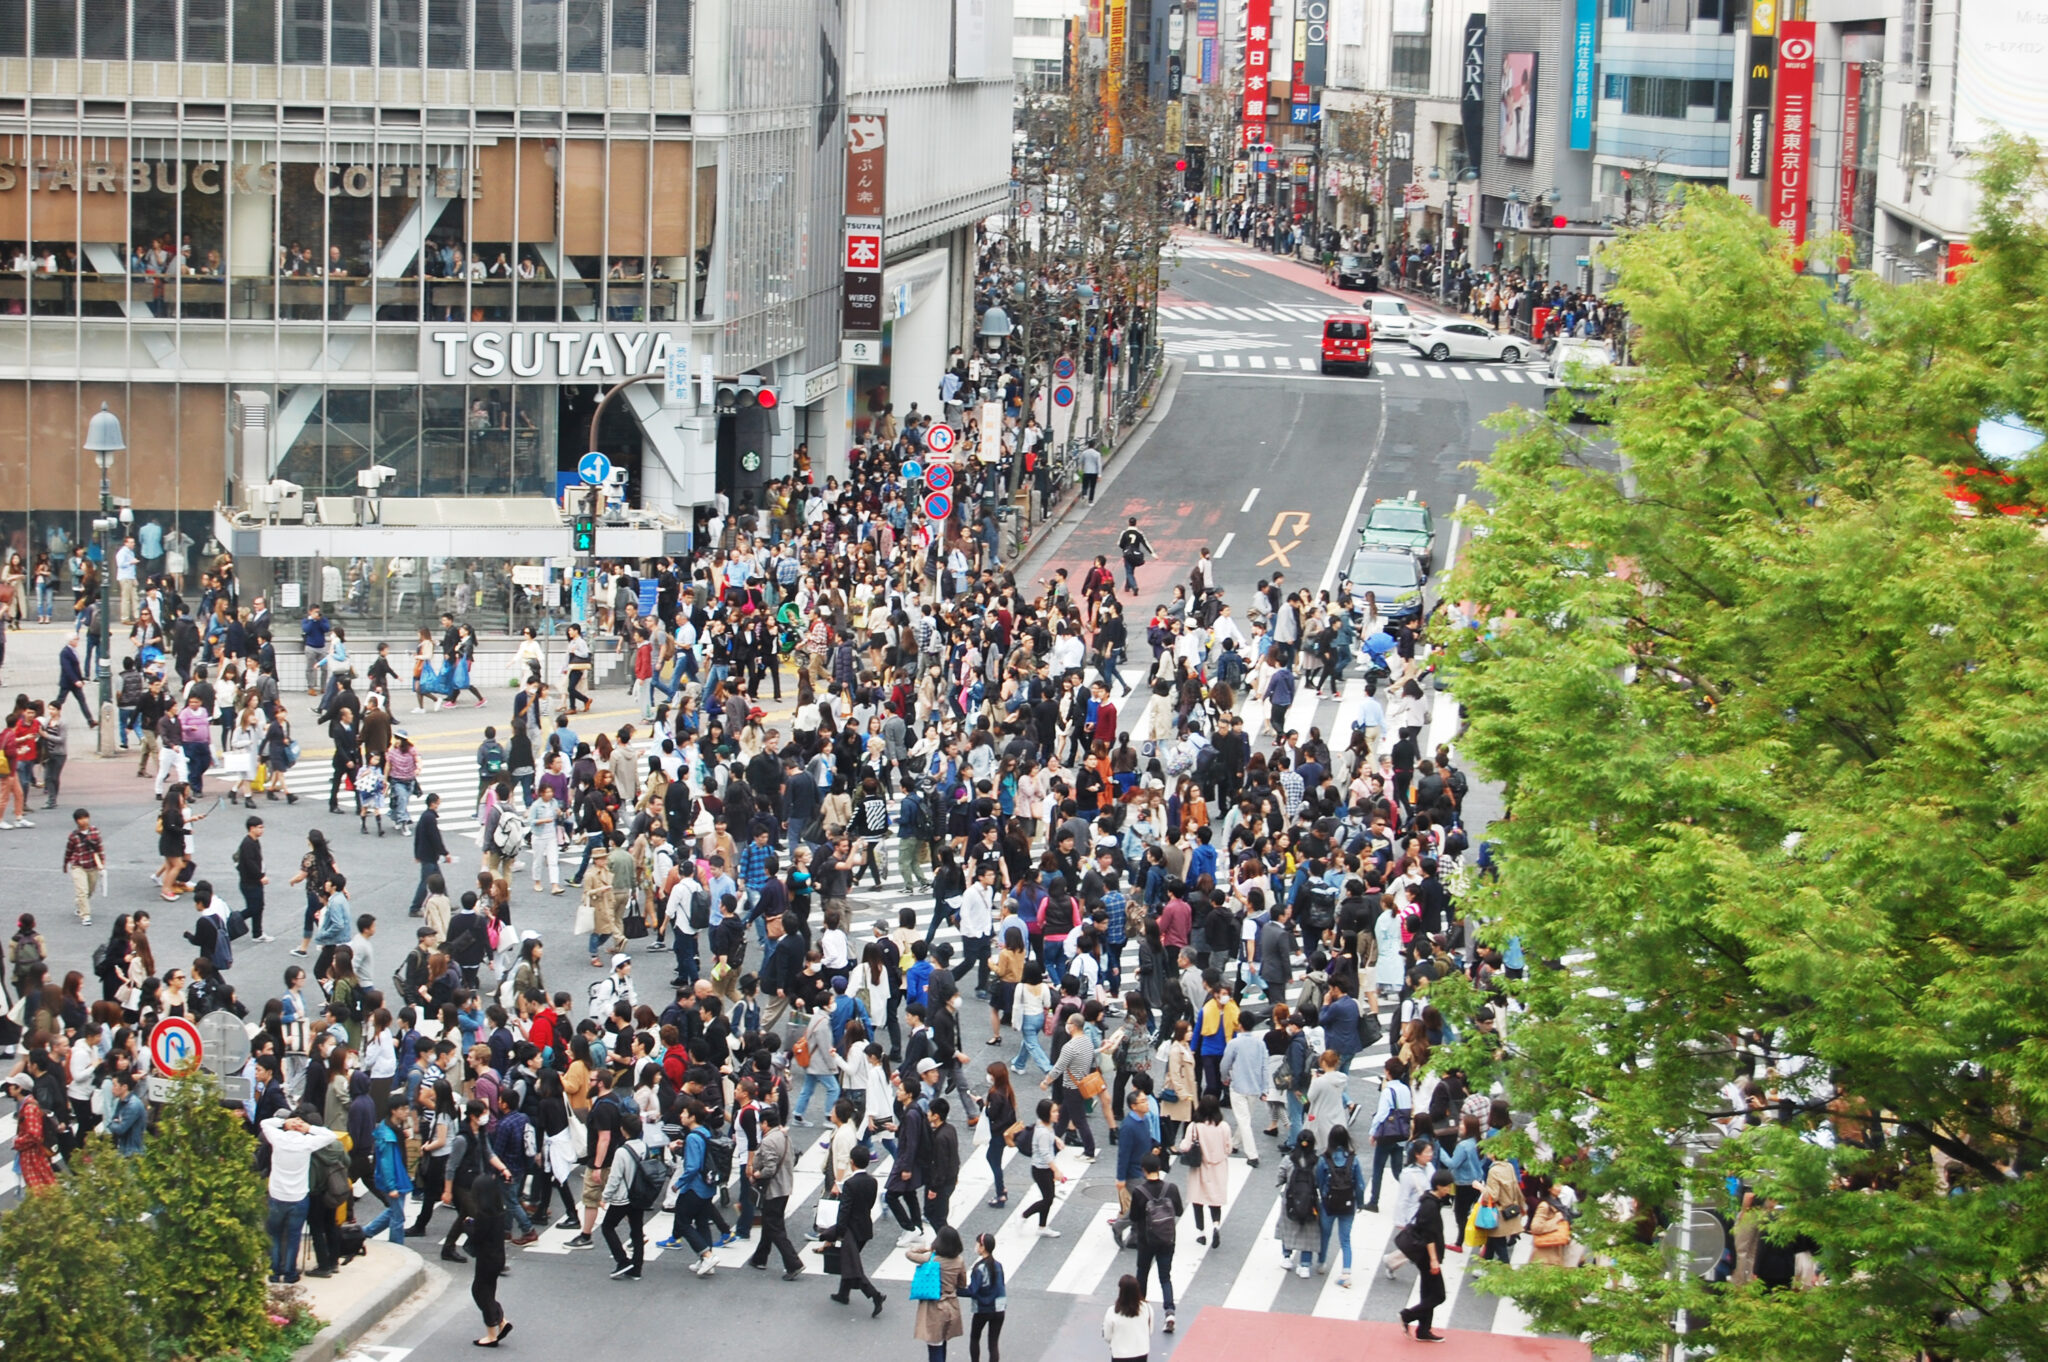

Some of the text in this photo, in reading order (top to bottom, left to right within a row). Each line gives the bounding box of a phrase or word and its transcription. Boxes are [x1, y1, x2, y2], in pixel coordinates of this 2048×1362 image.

[1111, 6, 1123, 36] TOWER
[1245, 25, 1267, 143] 東日本銀行
[1463, 28, 1483, 101] ZARA
[1575, 22, 1592, 119] 三井住友信託銀行
[1750, 113, 1763, 175] McDonald's
[0, 158, 482, 199] STARBUCKS COFFEE
[857, 158, 873, 204] ぶん楽
[1502, 201, 1529, 228] ZARA
[851, 239, 875, 265] 本
[848, 294, 876, 303] WIRED
[433, 331, 671, 377] TSUTAYA
[1129, 533, 1137, 544] 7
